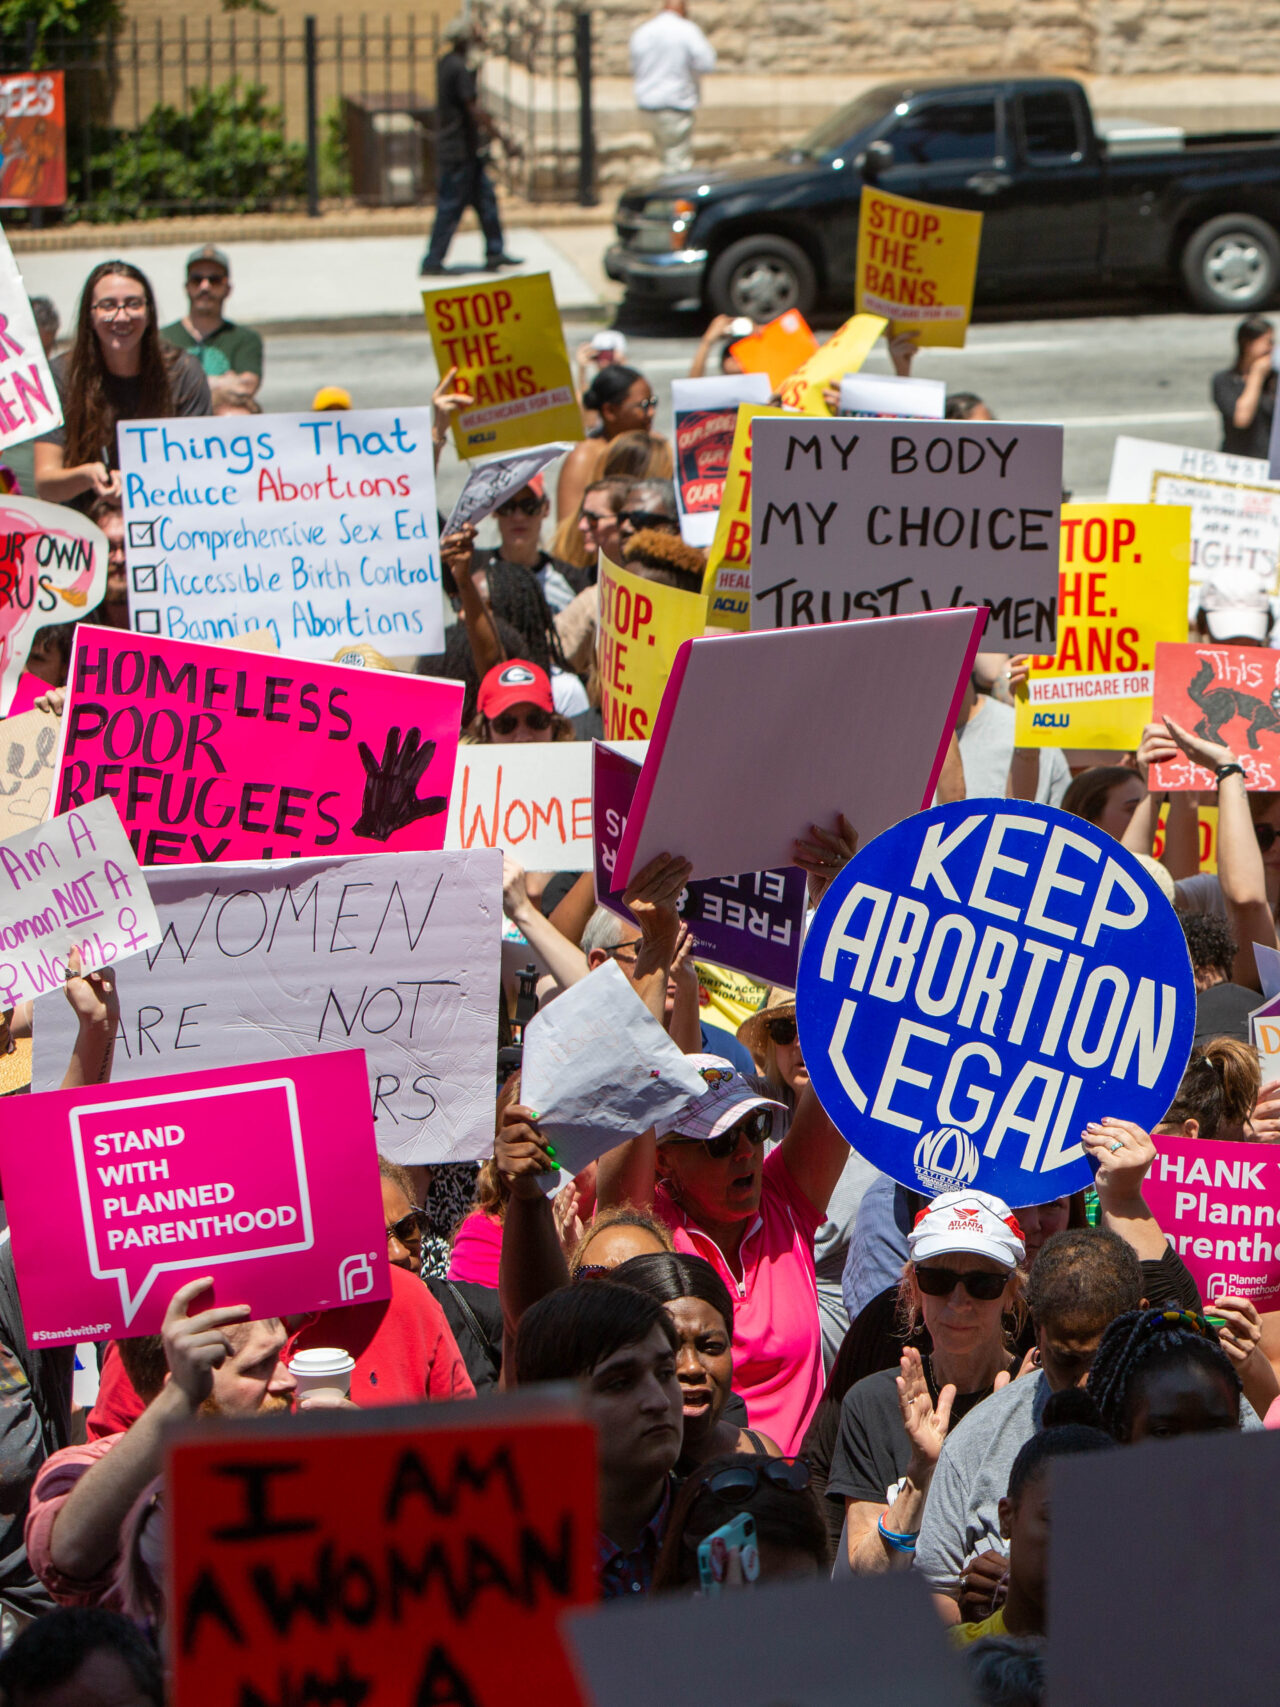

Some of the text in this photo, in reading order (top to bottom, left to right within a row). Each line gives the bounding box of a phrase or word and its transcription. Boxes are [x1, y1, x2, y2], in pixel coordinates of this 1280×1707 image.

[867, 199, 944, 245] STOP.
[867, 231, 923, 274] THE.
[864, 264, 944, 308] BANS.
[434, 290, 521, 334] STOP.
[441, 332, 513, 369] THE.
[453, 366, 546, 410] BANS.
[126, 418, 417, 474] Things That
[785, 434, 1019, 478] MY BODY
[126, 473, 238, 509] Reduce
[257, 465, 411, 502] Abortions
[686, 482, 720, 505] OUR
[159, 509, 429, 560] Comprehensive Sex Ed
[759, 501, 1053, 551] MY CHOICE
[1060, 518, 1141, 563] TOP.
[36, 534, 93, 572] OWN
[162, 553, 441, 596] Accessible Birth Control
[1191, 538, 1276, 577] IGHTS
[713, 597, 748, 614] ACLU
[755, 577, 914, 627] TRUST
[1058, 572, 1117, 617] HE.
[168, 599, 424, 647] Banning Abortions
[1032, 627, 1149, 672] ANS.
[1195, 650, 1264, 688] This
[75, 645, 353, 742] HOMELESS
[1033, 677, 1149, 701] HEALTHCARE FOR
[64, 702, 228, 774] POOR
[1033, 713, 1069, 728] ACLU
[58, 761, 342, 846] REFUGEES
[459, 765, 592, 849] WOME
[68, 813, 96, 858] A
[52, 871, 98, 919] NOT
[104, 860, 132, 899] A
[910, 813, 1149, 949] KEEP
[145, 873, 443, 970] WOMEN
[703, 893, 791, 946] FREE
[819, 881, 1177, 1090] ABORTION
[318, 980, 460, 1041] NOT
[828, 997, 1089, 1174] LEGAL
[93, 1125, 186, 1157] STAND
[913, 1127, 980, 1183] NOW
[97, 1158, 170, 1188] WITH
[915, 1167, 967, 1189] NATIONAL
[1144, 1153, 1270, 1191] THANK
[103, 1182, 236, 1220] PLANNED
[107, 1205, 298, 1251] PARENTHOOD
[948, 1220, 983, 1230] ATLANTA
[1228, 1285, 1280, 1295] Parenthood
[1229, 1274, 1268, 1284] Planned
[32, 1323, 112, 1341] #StandwithPP
[209, 1441, 525, 1542] I AM
[180, 1511, 575, 1654] A WOMAN
